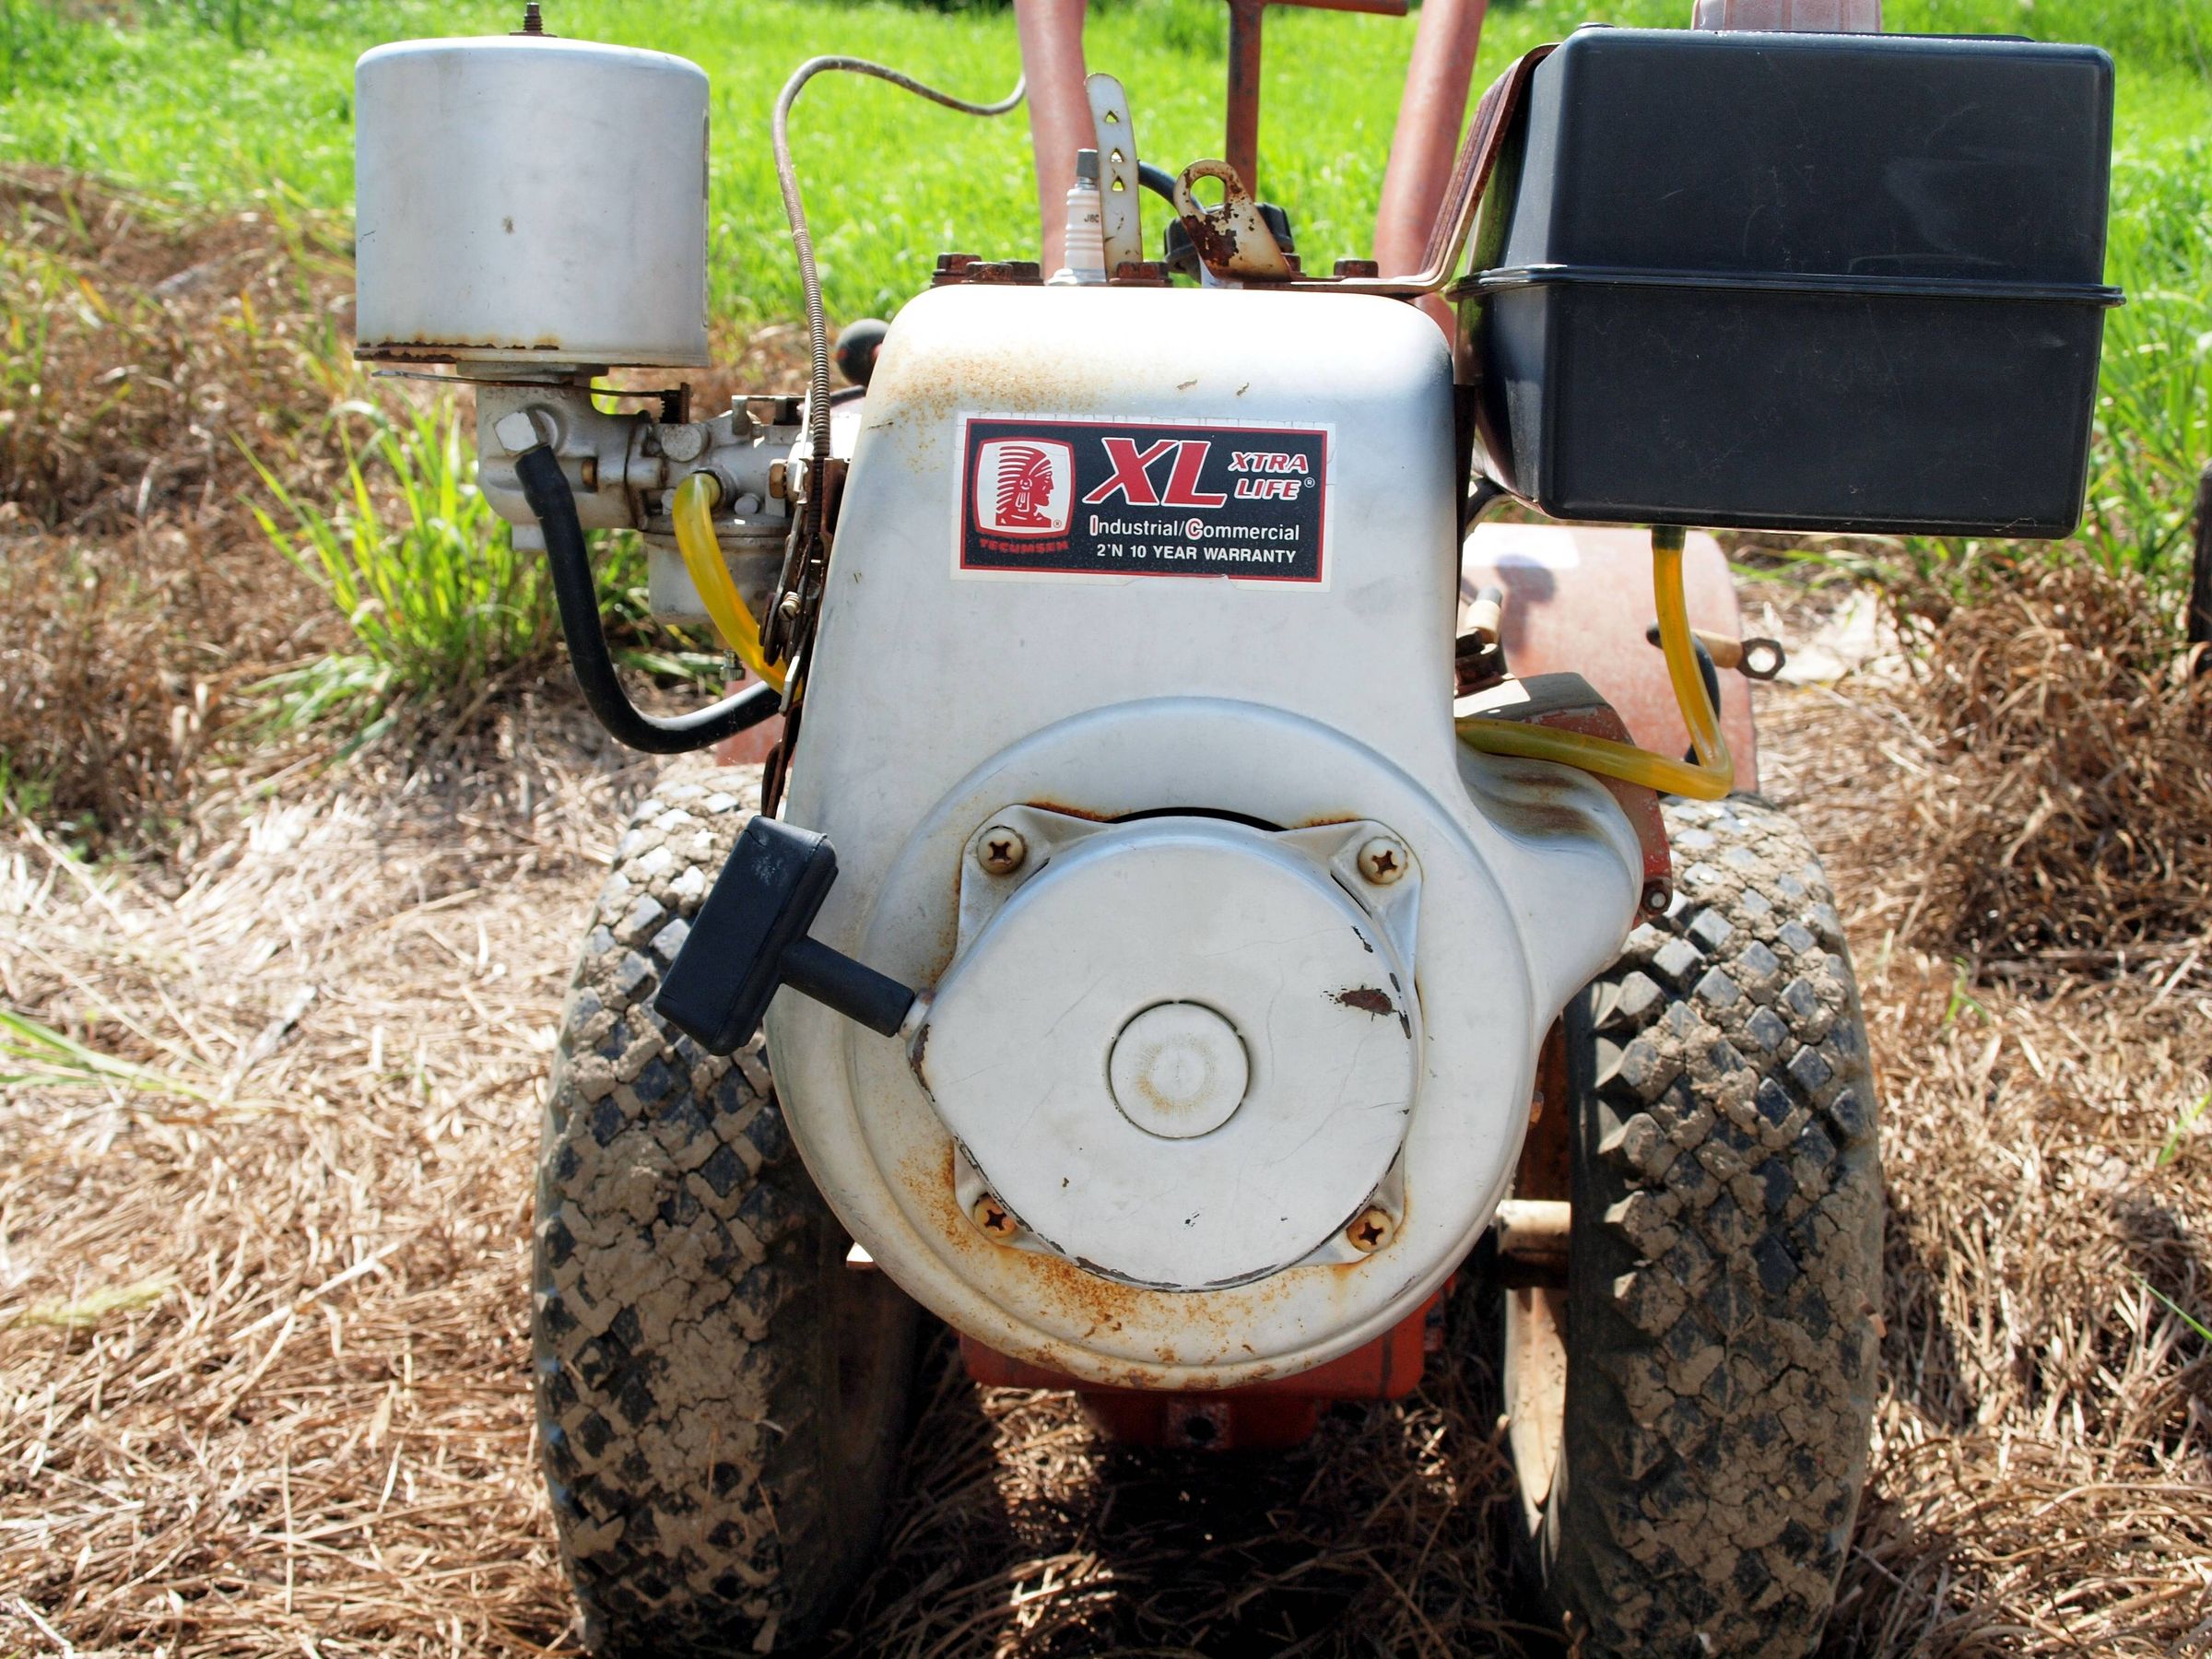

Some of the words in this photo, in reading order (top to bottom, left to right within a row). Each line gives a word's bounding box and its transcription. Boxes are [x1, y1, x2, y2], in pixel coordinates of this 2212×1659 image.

[1082, 437, 1227, 507] XL
[1229, 452, 1309, 474] XTRA
[1090, 515, 1300, 540] Industrial/Commercial
[979, 537, 1068, 554] TECUMSEH
[1131, 545, 1146, 559] 10
[1154, 546, 1198, 560] YEAR
[1204, 547, 1296, 563] WARRANTY
